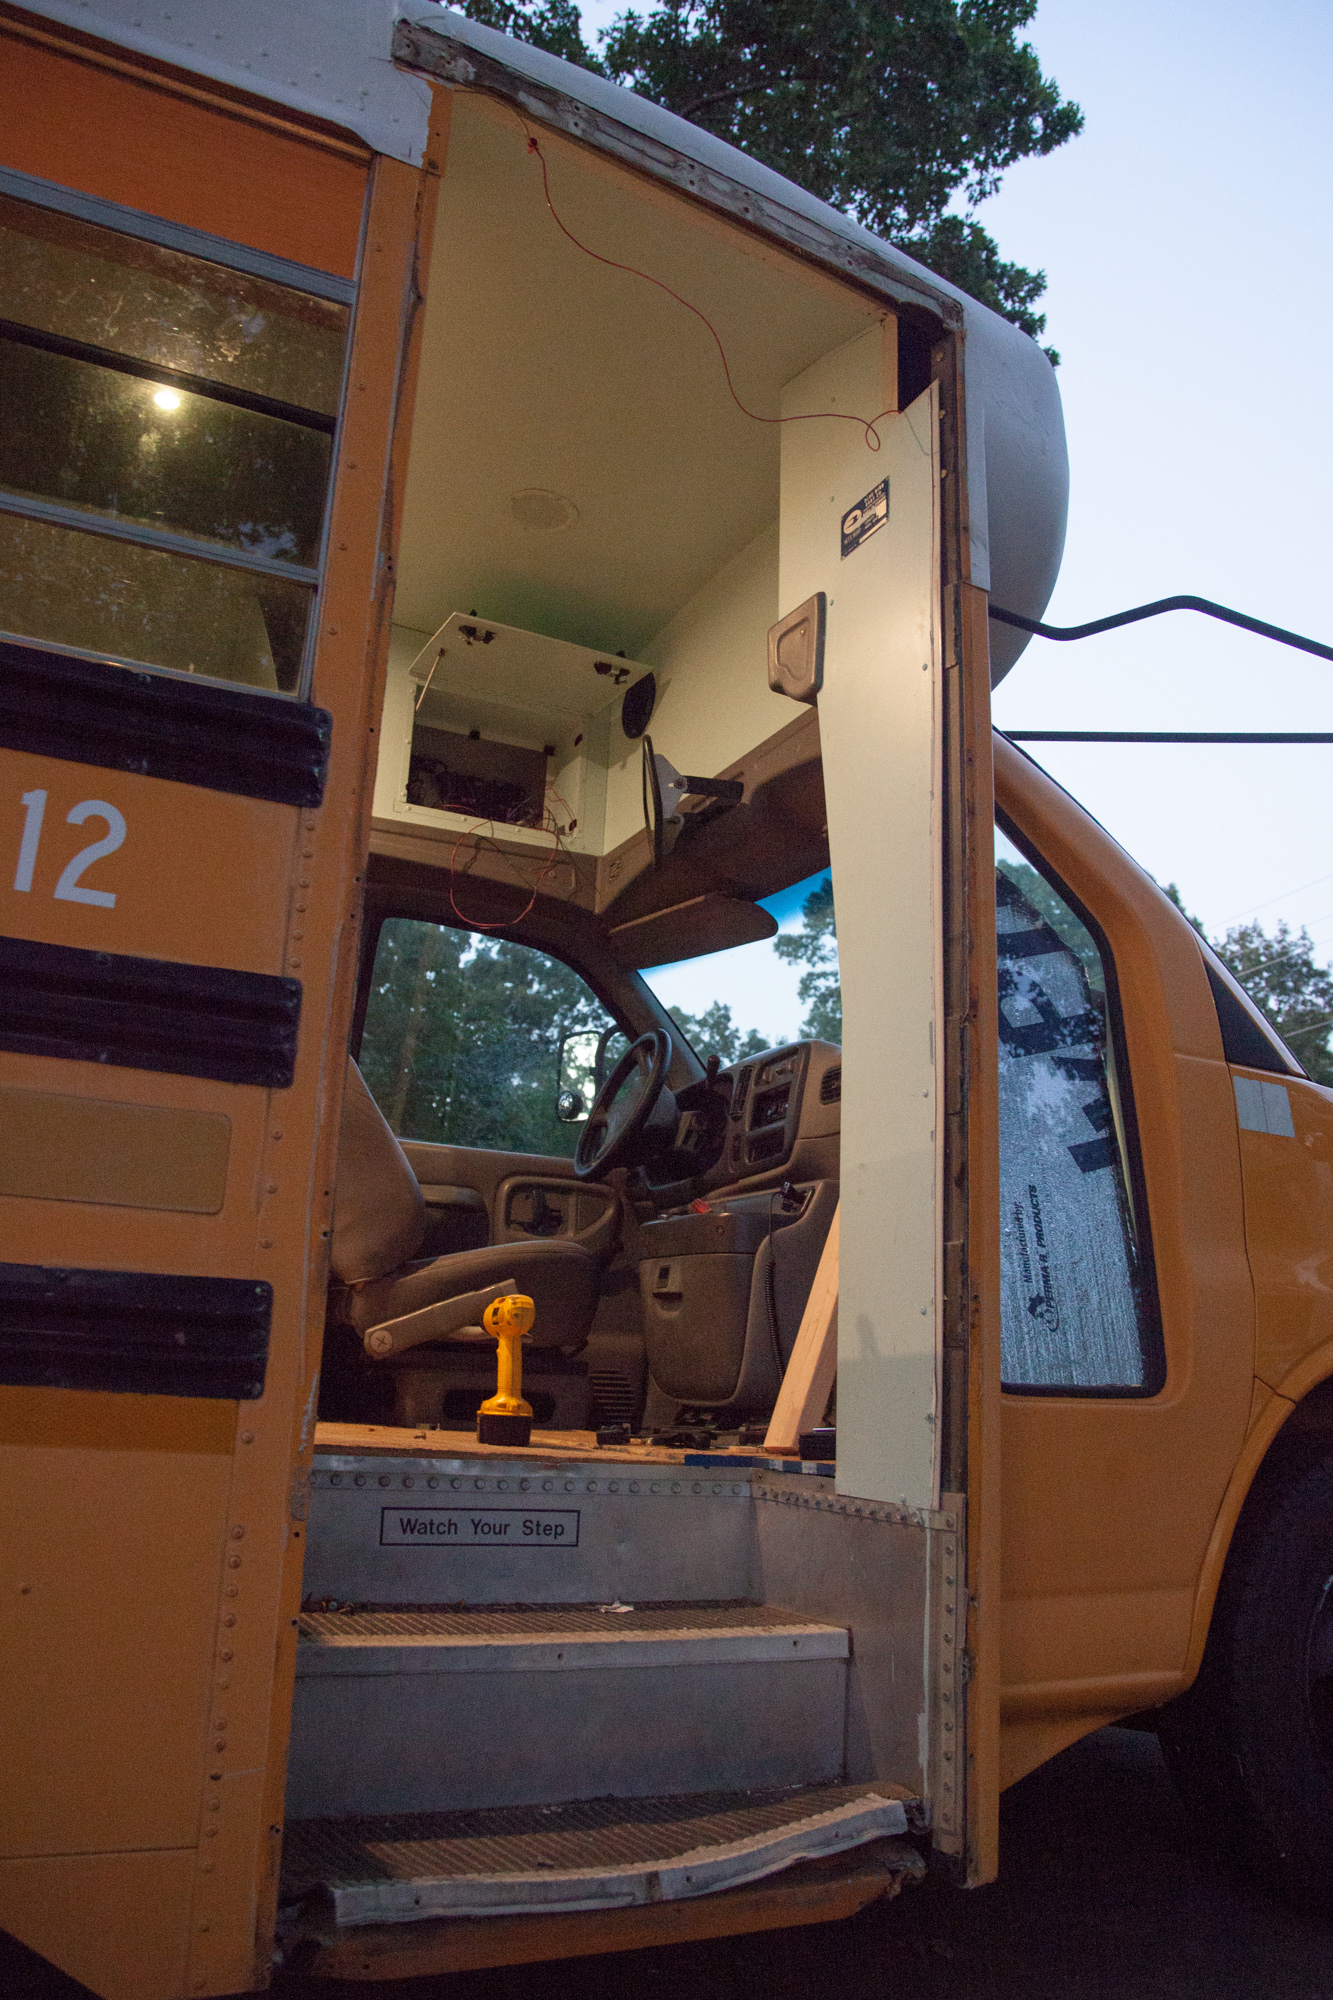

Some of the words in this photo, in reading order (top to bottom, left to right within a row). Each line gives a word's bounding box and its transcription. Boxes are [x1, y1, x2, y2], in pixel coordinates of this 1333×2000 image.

[13, 788, 127, 909] 12
[1027, 1184, 1046, 1248] PRODUCTS
[1013, 1217, 1033, 1284] Manufactured
[1040, 1265, 1054, 1314] PERMA
[400, 1518, 458, 1535] Watch
[471, 1519, 510, 1536] Your
[522, 1519, 565, 1539] Step
